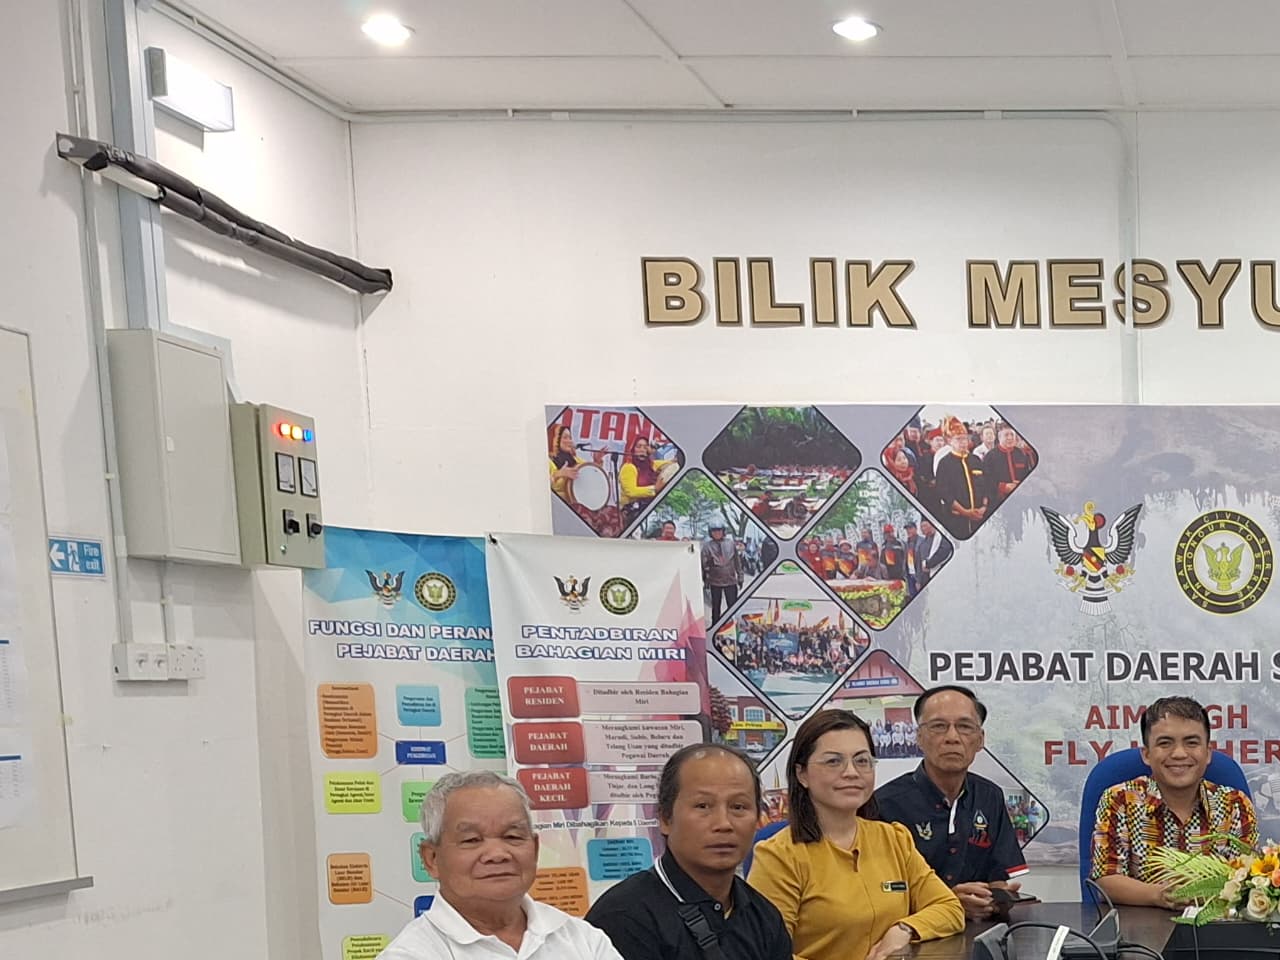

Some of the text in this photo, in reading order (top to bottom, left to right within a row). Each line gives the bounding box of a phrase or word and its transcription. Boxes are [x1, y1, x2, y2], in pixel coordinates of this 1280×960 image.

[641, 257, 918, 330] BILIK
[83, 543, 100, 557] Fire
[1187, 522, 1226, 571] HONOUR
[1238, 526, 1253, 541] TO
[86, 559, 99, 570] exit
[1177, 512, 1271, 608] SARAWAK CIVIL SERVICE
[309, 620, 494, 640] FUNGSI DAN PERAN
[522, 625, 678, 641] PENTADBIRAN
[337, 643, 421, 660] PEJABAT
[516, 645, 687, 661] BAHAGIAN MIRI
[929, 651, 1094, 682] PEJABAT
[1106, 651, 1260, 682] DAERAH
[523, 686, 564, 695] PEJABAT
[525, 697, 565, 706] RESIDEN
[528, 732, 568, 741] PEJABAT
[530, 743, 568, 752] DAERAH
[1043, 741, 1114, 766] FLY
[532, 772, 571, 781] PEJABAT
[533, 783, 571, 792] DAERAH
[539, 794, 567, 802] KECIL
